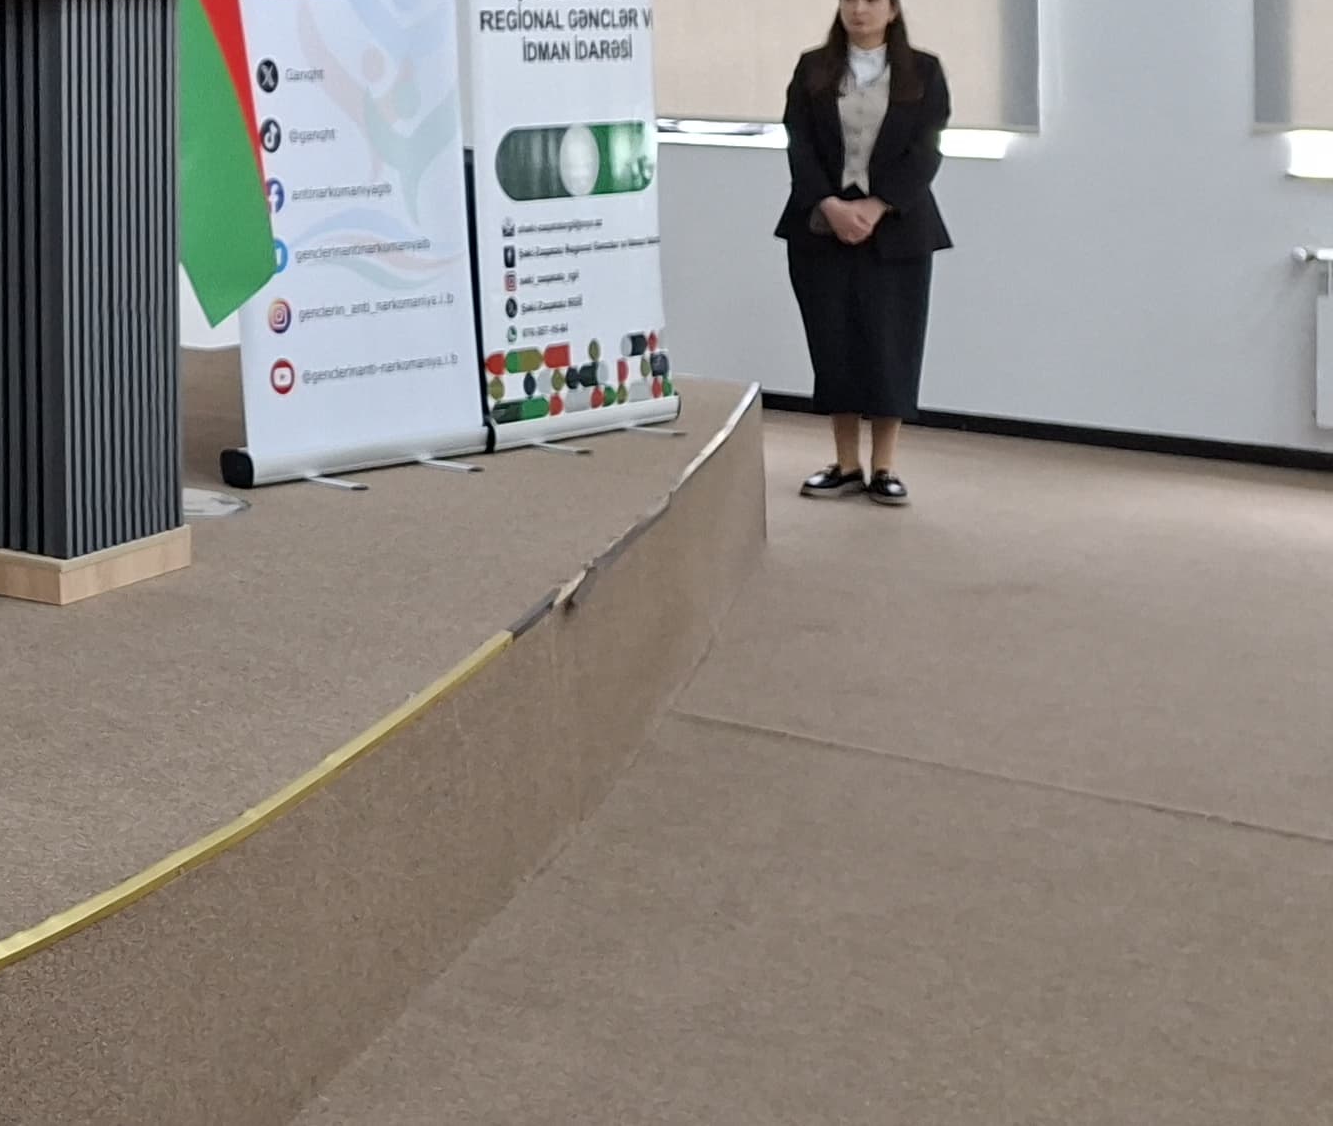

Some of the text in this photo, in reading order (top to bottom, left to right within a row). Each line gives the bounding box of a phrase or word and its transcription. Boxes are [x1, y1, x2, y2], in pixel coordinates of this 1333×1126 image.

[568, 8, 638, 30] GƏNCLƏR
[641, 8, 654, 30] V
[523, 34, 633, 62] İDMAN İDARƏSİ
